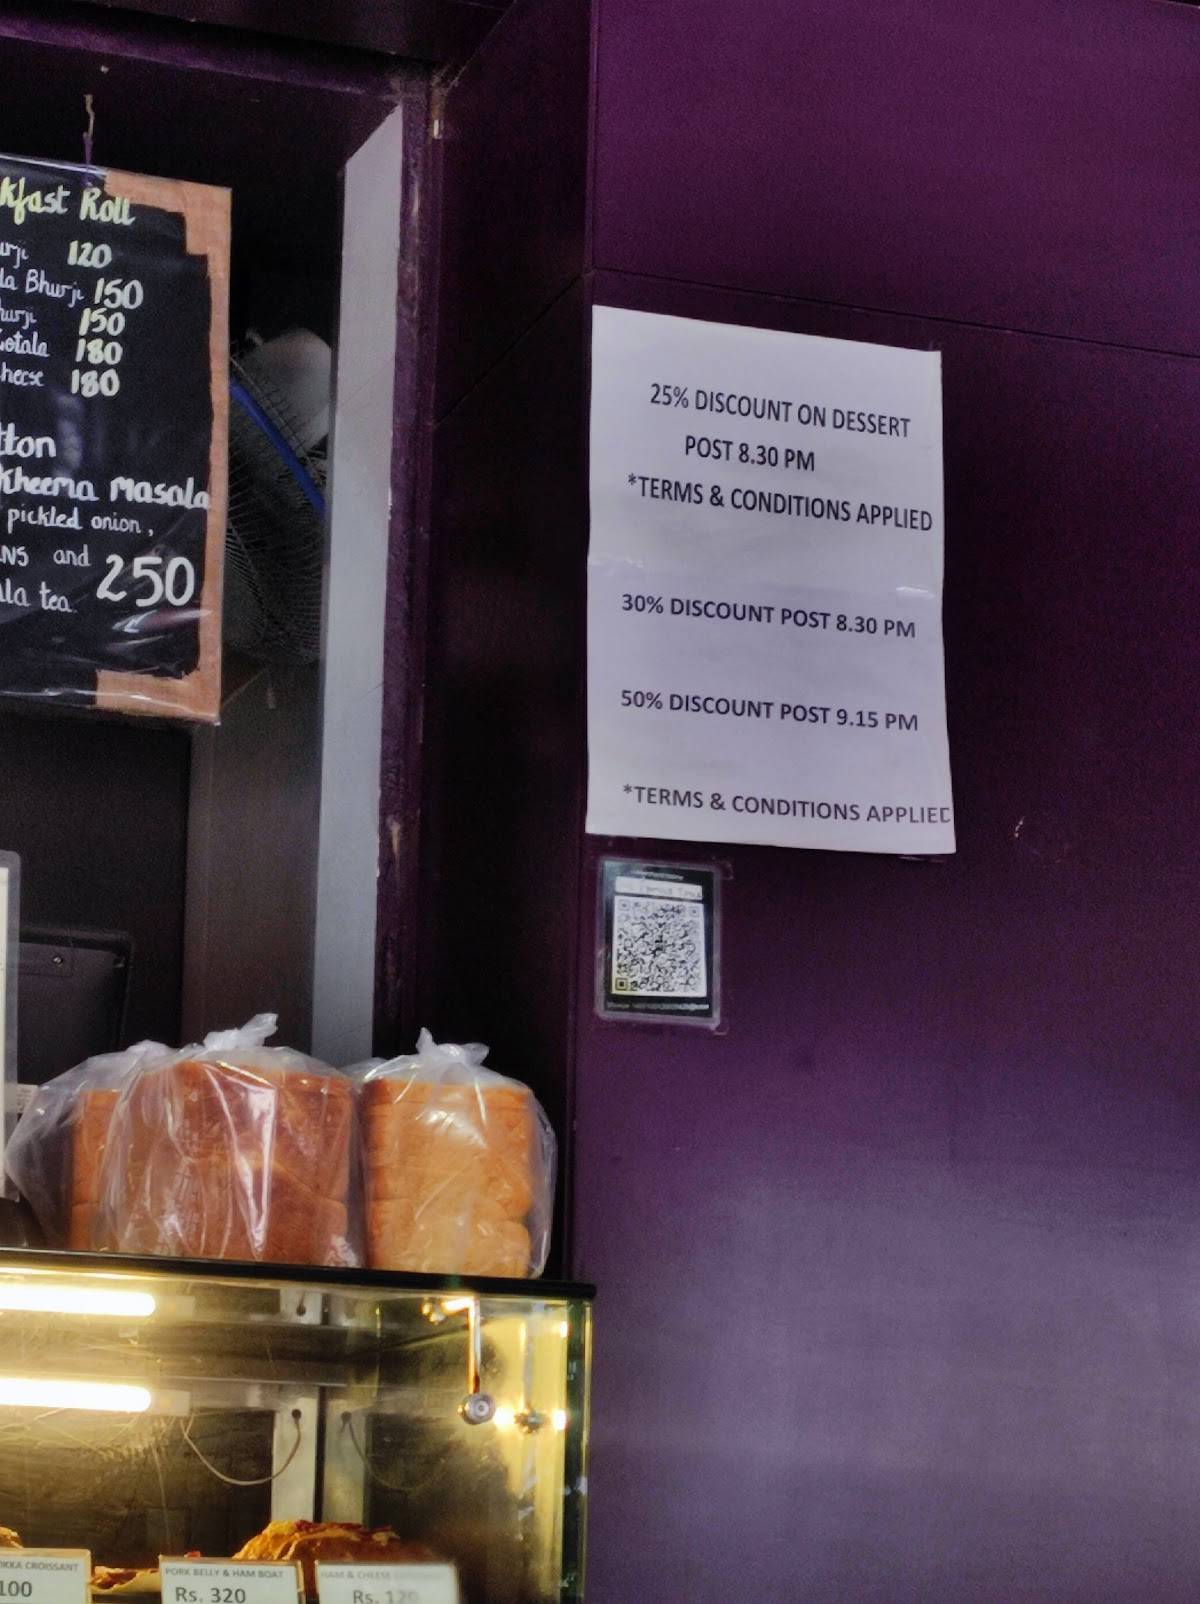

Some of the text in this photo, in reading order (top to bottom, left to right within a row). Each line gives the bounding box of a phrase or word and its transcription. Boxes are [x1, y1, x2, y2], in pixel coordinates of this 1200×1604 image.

[79, 187, 136, 225] Roll
[67, 240, 113, 268] 120
[94, 278, 144, 309] 150
[79, 307, 126, 336] 150
[75, 338, 123, 365] 180
[71, 369, 120, 397] 180
[650, 383, 911, 438] 25% DISCOUNT ON DESSERT
[685, 435, 815, 472] POST 8.30 PM
[7, 503, 83, 534] pickled
[709, 485, 725, 507] &
[731, 488, 851, 521] CONDITIONS
[856, 503, 933, 531] APPLIED
[0, 543, 92, 567] NS and
[0, 578, 31, 607] la
[96, 554, 195, 606] 250
[621, 594, 916, 638] 30% DISCOUNT POST 8.30 PM
[621, 689, 919, 731] 50% DISCOUNT POST 9.15 PM
[710, 792, 726, 811] &
[731, 795, 860, 821] CONDITIONS
[25, 1561, 78, 1572] CROISSANT
[165, 1567, 284, 1579] PORK BELLY & HAM BOAT
[0, 1580, 32, 1597] 100
[175, 1586, 246, 1604] Rs. 320
